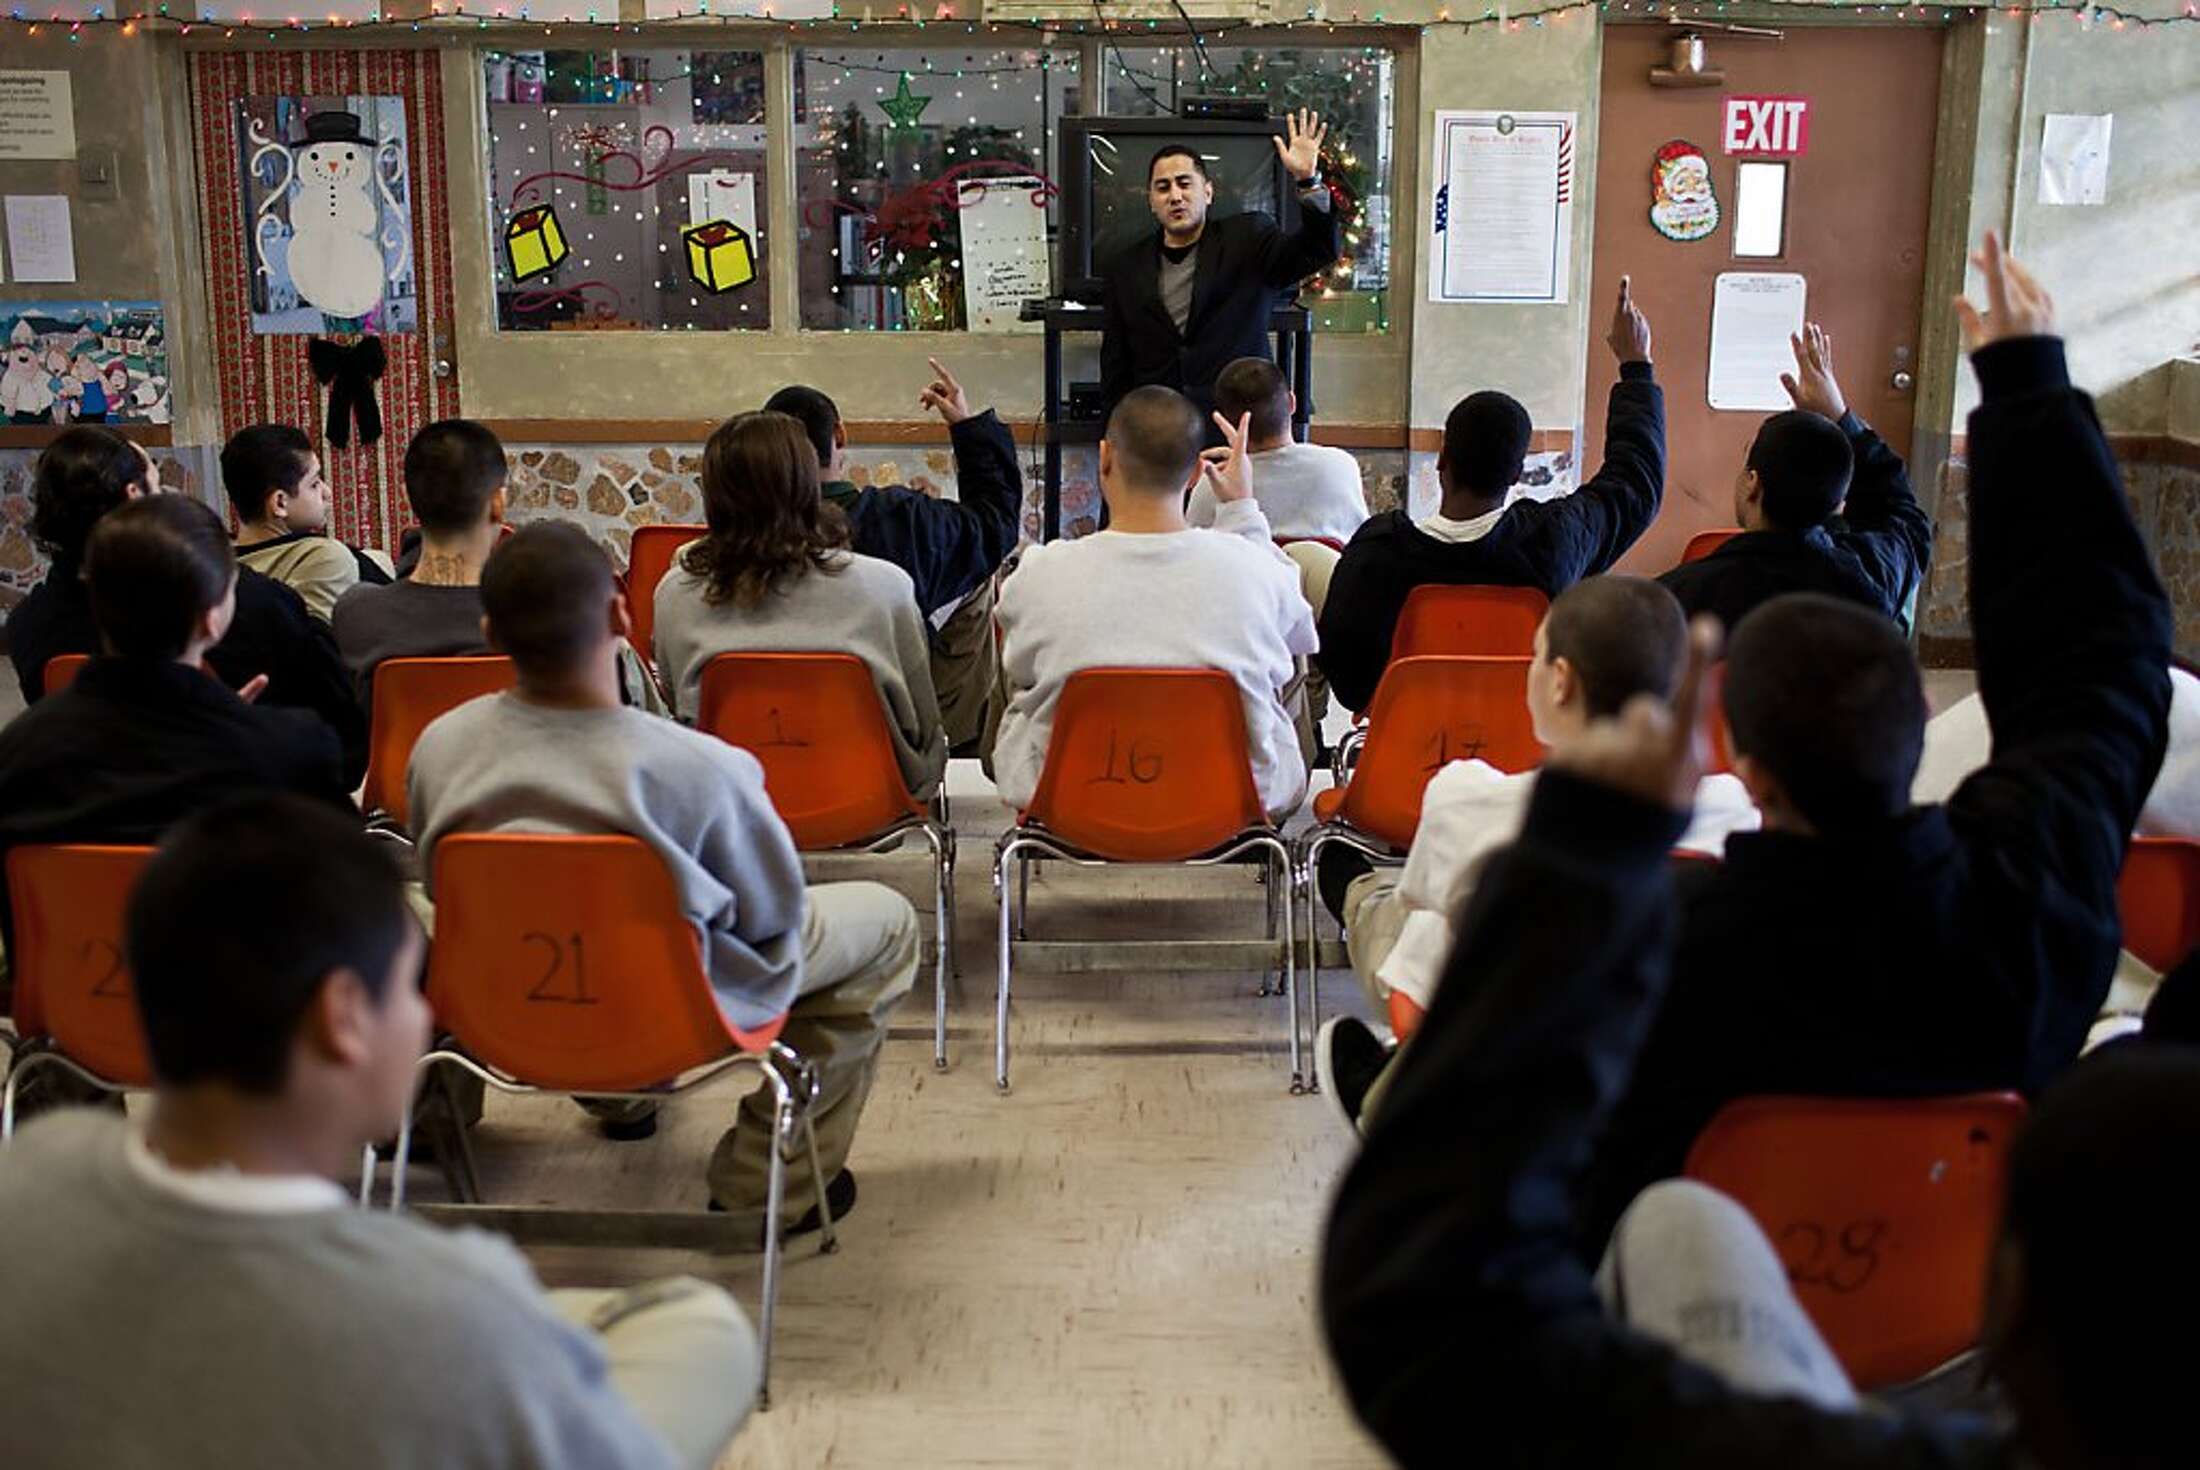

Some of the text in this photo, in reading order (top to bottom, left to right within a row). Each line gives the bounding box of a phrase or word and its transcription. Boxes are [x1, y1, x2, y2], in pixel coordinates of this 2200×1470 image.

[1725, 100, 1806, 151] EXIT
[1086, 727, 1164, 785] 16
[1422, 721, 1489, 773] 17
[81, 936, 130, 999] 2
[521, 930, 601, 1006] 21
[1783, 1217, 1889, 1294] 28
